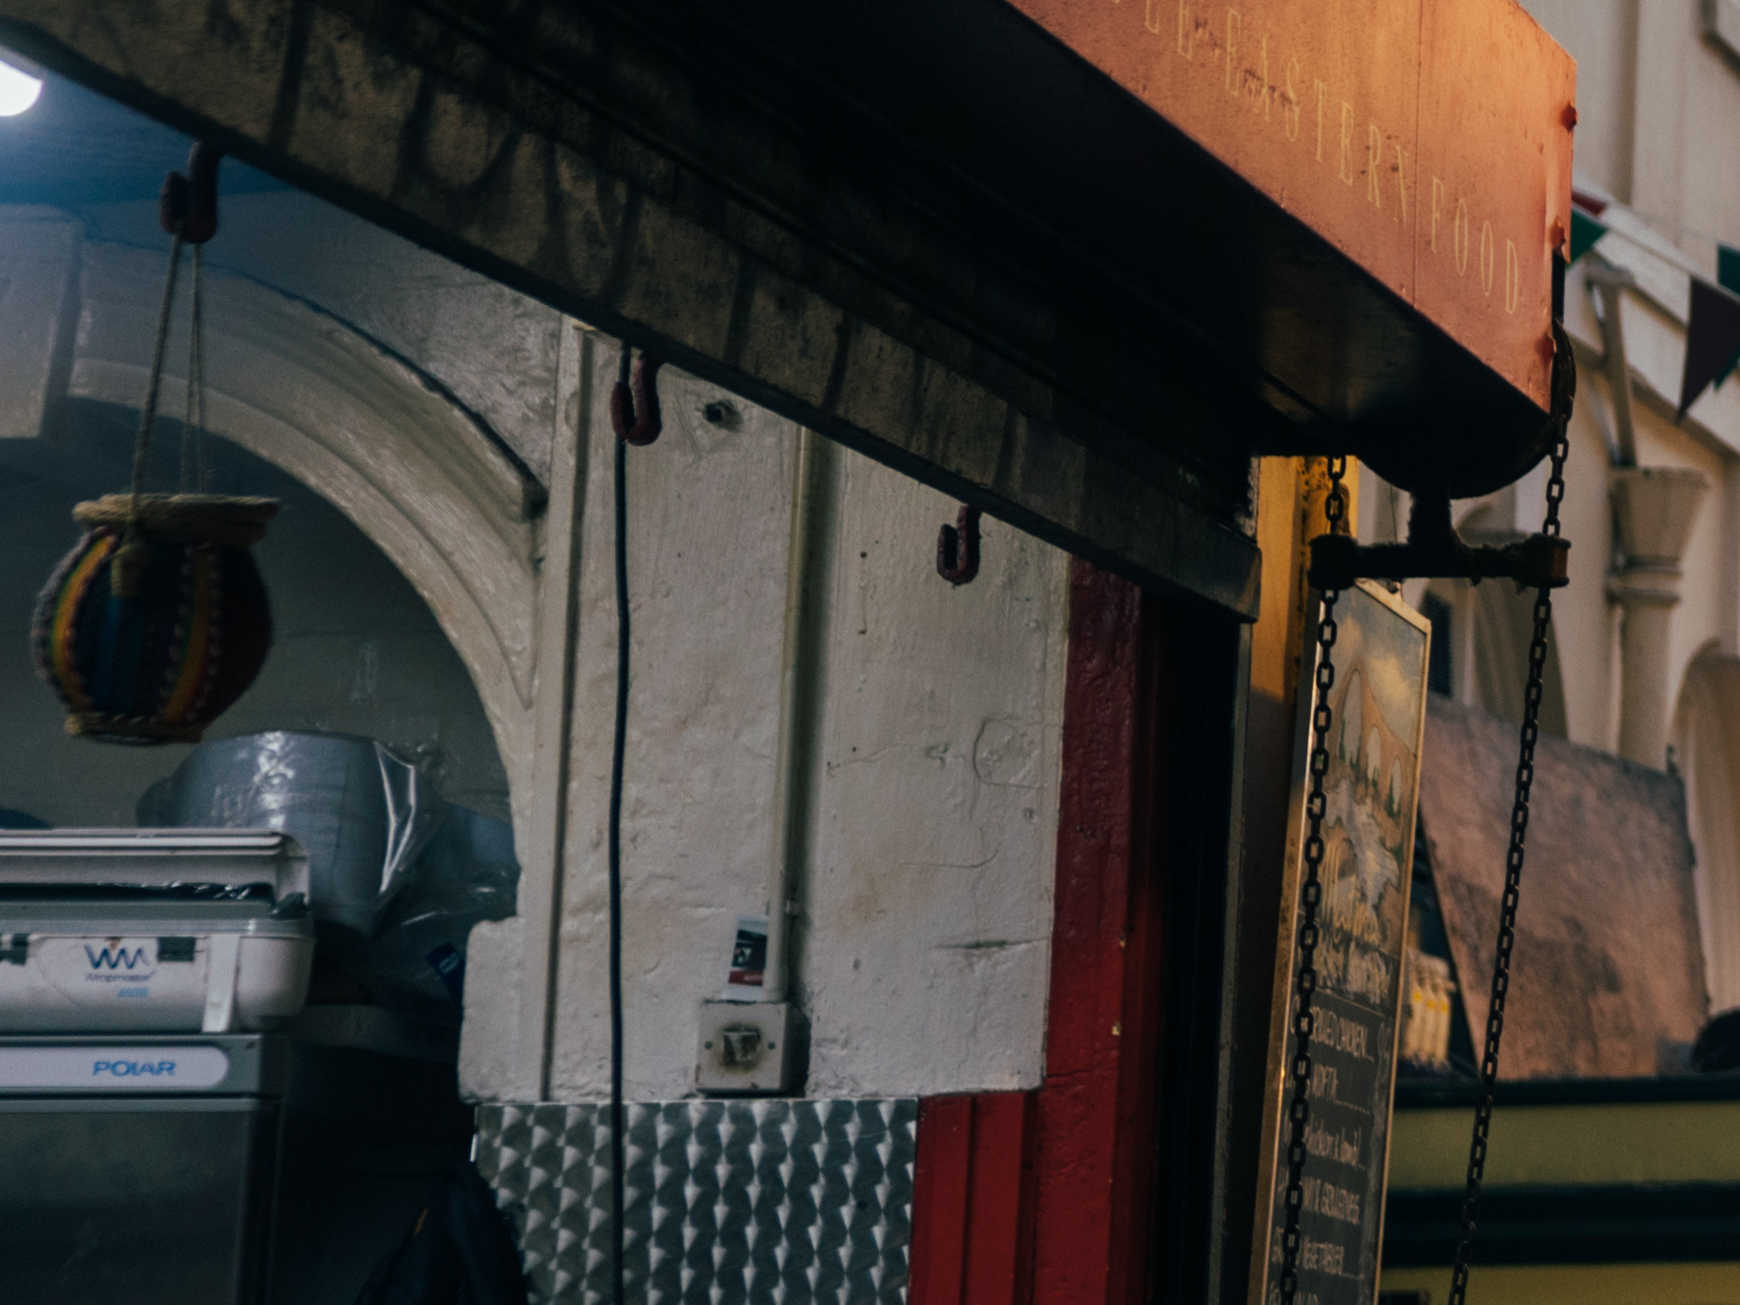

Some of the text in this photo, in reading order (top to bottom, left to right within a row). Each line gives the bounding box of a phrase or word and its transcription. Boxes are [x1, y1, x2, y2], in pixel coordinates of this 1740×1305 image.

[1225, 6, 1411, 225] EASTERN
[1431, 175, 1520, 316] FOOD
[93, 1061, 176, 1077] POLAR
